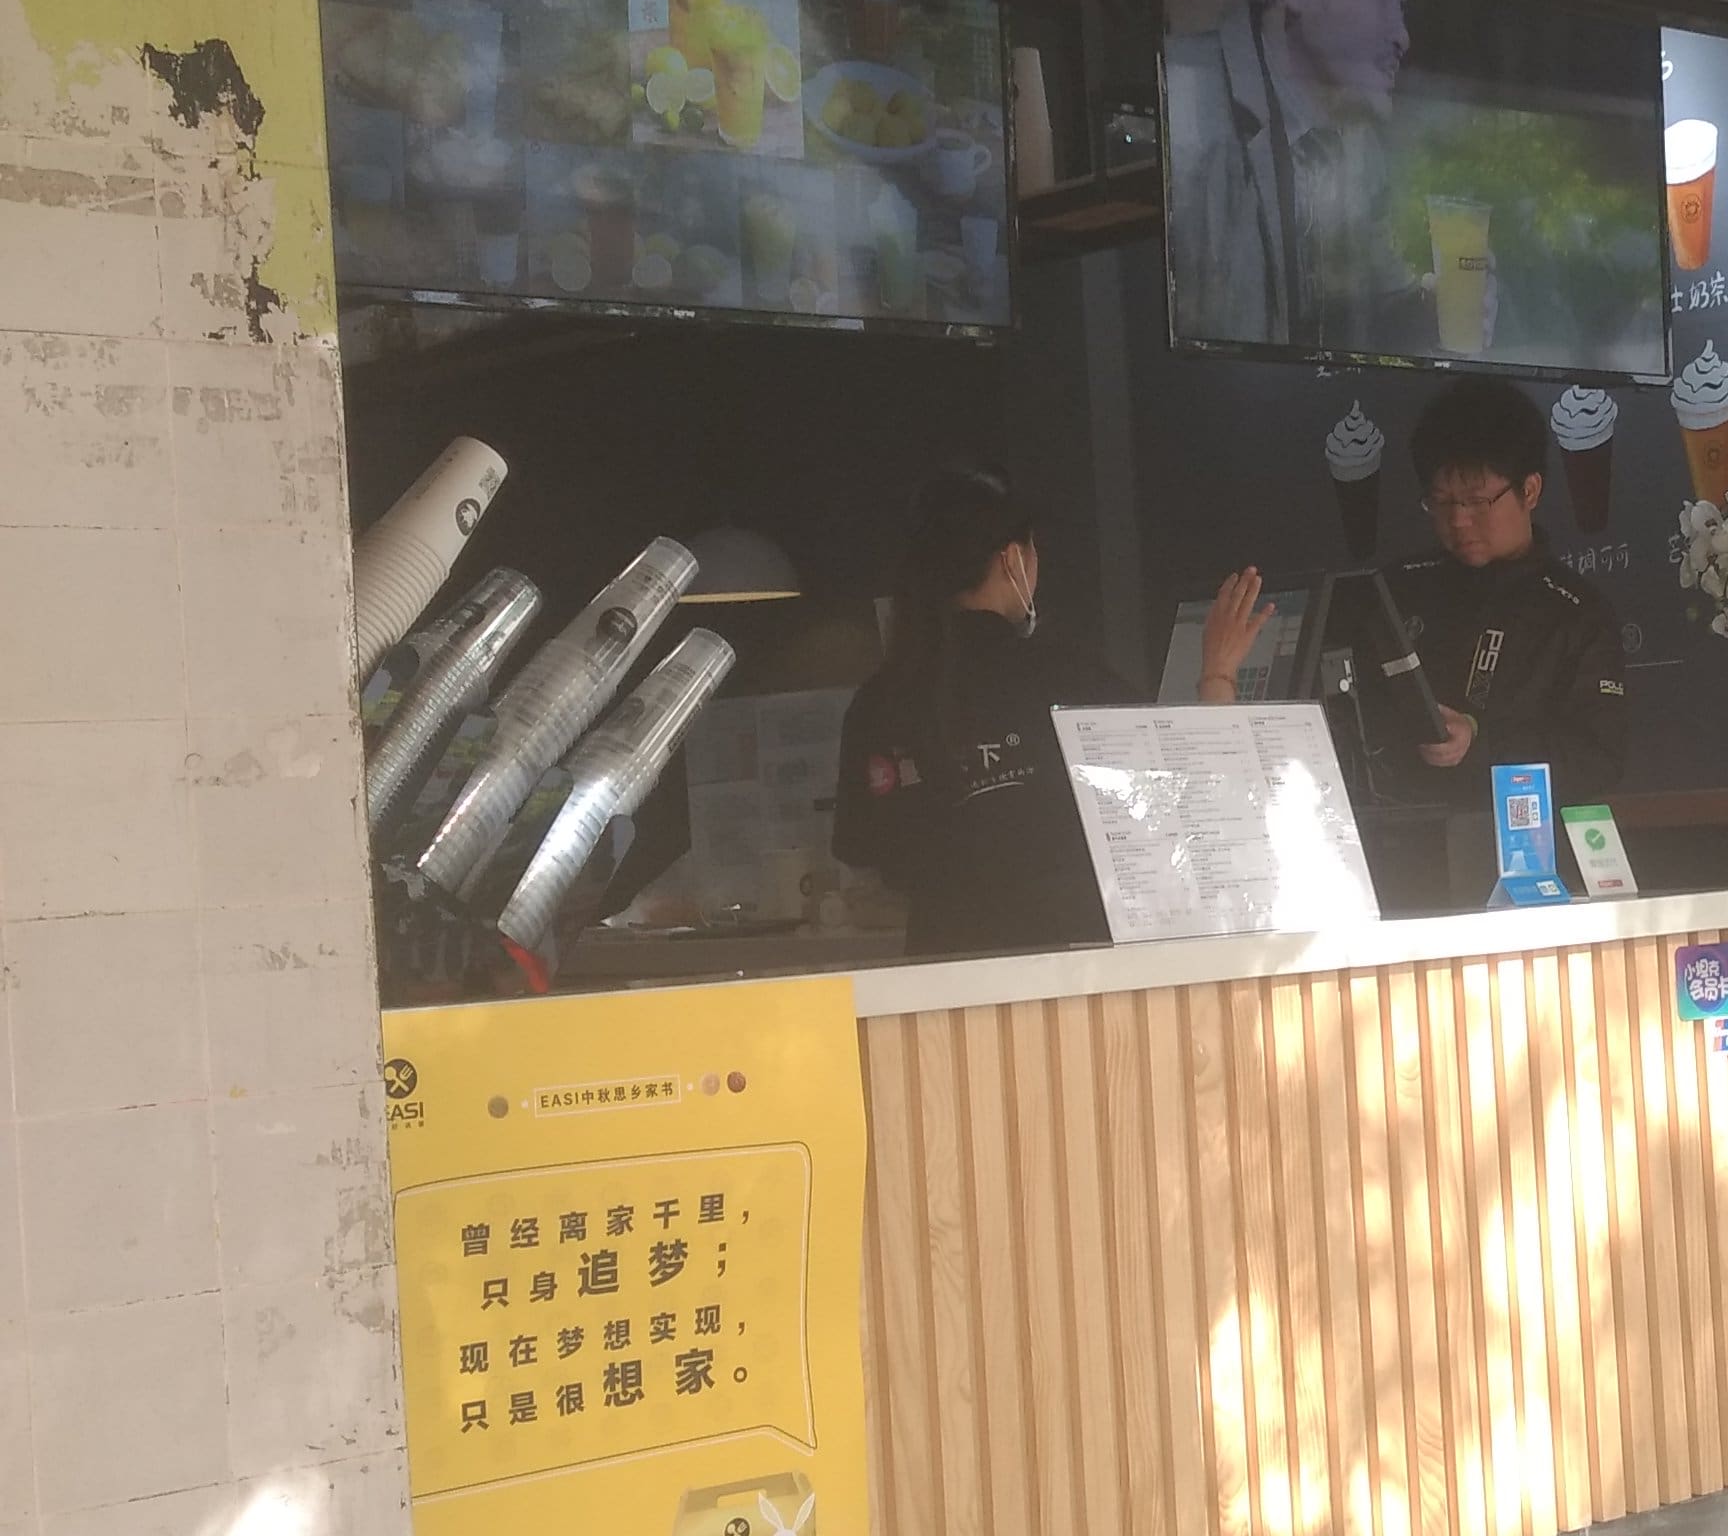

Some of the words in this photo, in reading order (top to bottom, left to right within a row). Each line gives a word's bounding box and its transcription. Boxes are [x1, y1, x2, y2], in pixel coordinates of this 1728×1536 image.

[540, 1081, 674, 1109] EASI中秋思乡家书
